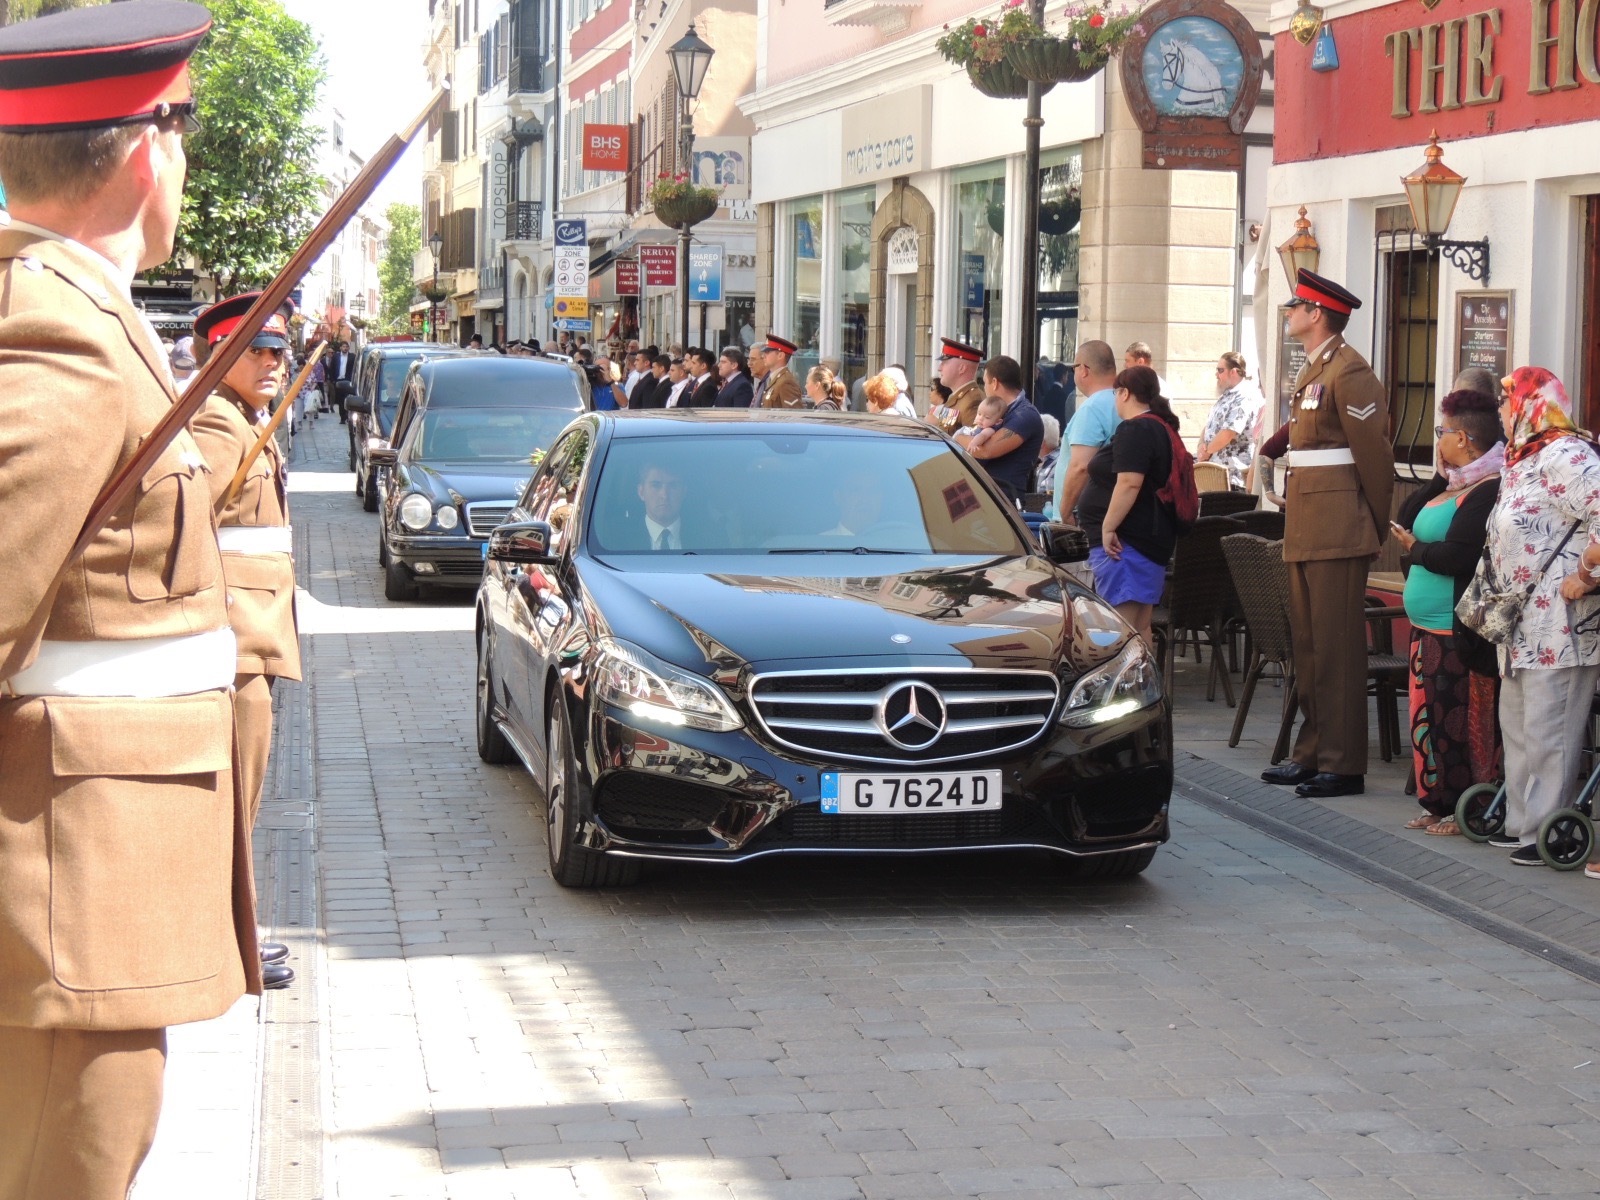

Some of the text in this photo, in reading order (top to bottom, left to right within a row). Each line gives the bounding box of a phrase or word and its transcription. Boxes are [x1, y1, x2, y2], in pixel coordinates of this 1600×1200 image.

[1384, 8, 1504, 119] THE
[591, 135, 621, 149] BHS
[590, 149, 621, 159] HOME
[846, 133, 914, 176] mothercare
[493, 152, 507, 230] TOPSHOP
[561, 226, 582, 237] Kelly's
[641, 248, 675, 256] SERUYA
[689, 253, 719, 261] SHARED
[160, 268, 182, 276] Chips
[1474, 331, 1494, 340] Starters
[854, 775, 989, 808] G 7624 D
[822, 797, 838, 806] GBZ
